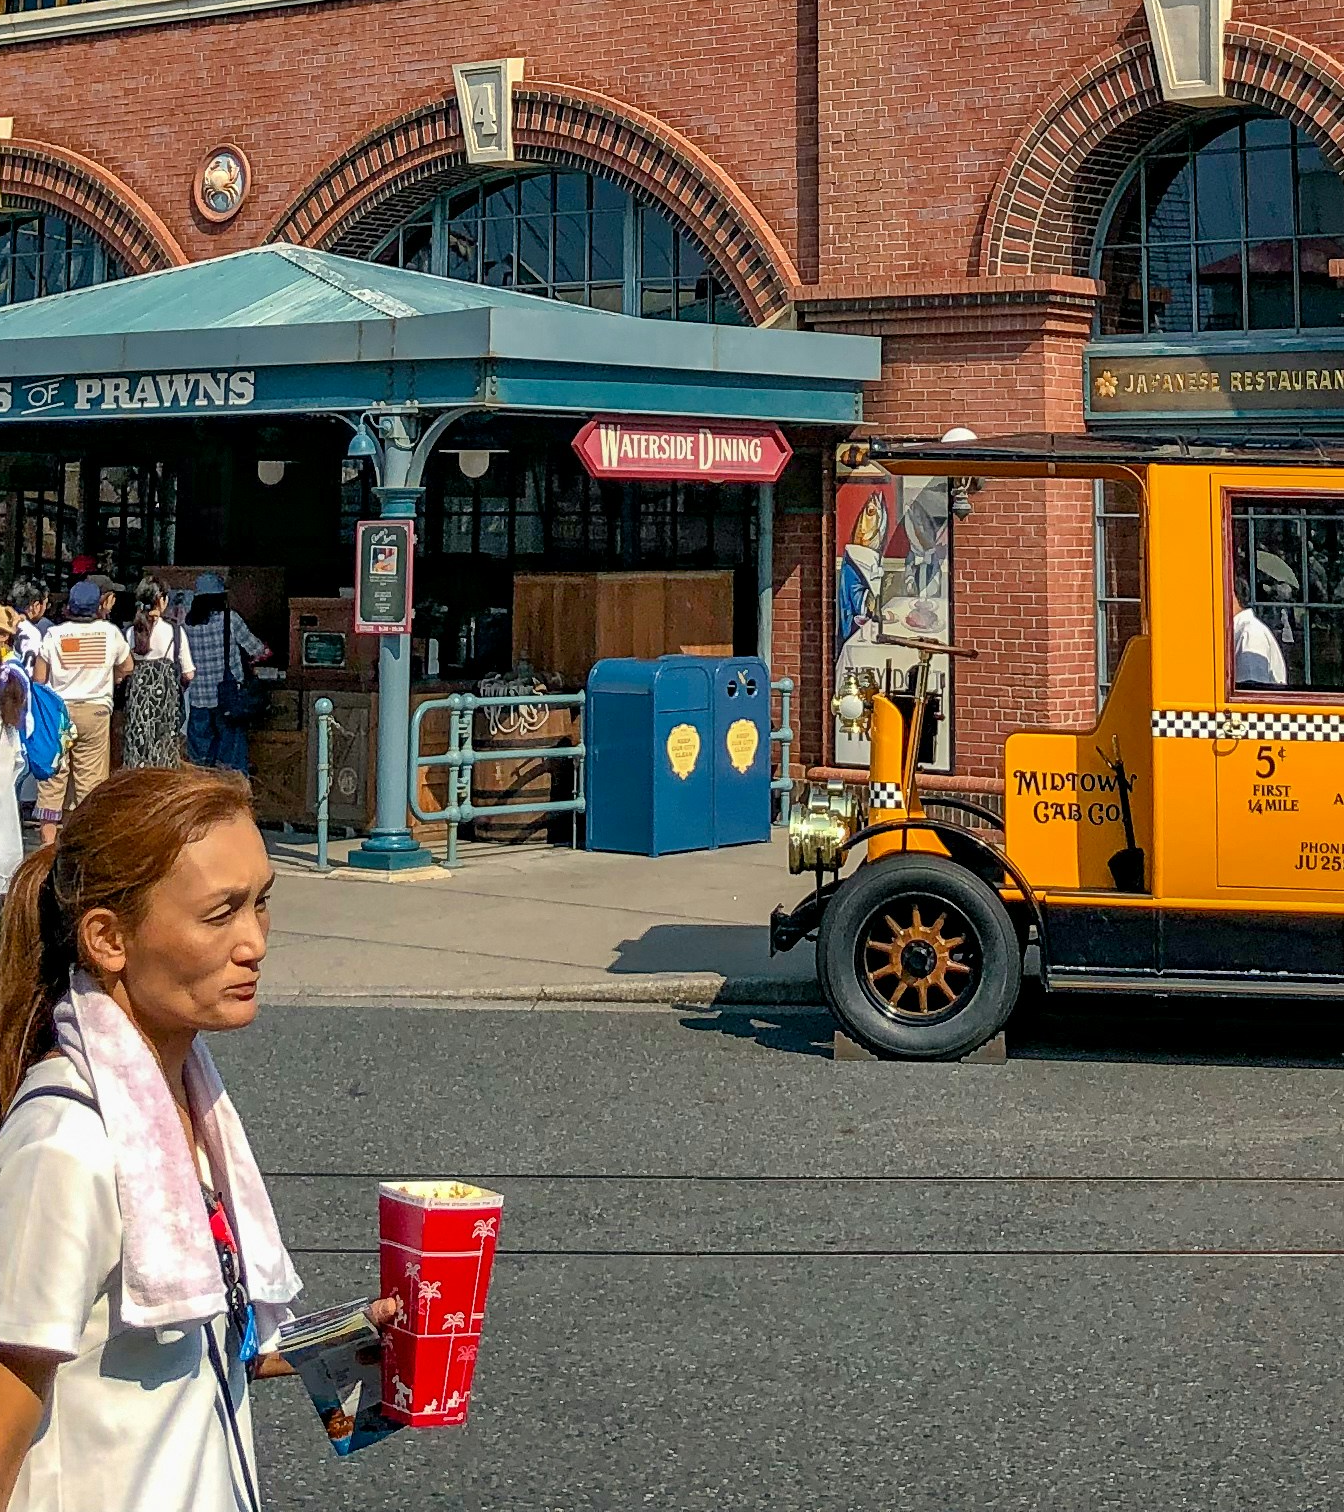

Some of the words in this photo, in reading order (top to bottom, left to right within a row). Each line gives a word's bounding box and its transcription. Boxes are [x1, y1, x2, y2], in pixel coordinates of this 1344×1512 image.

[27, 382, 61, 407] OF
[74, 370, 256, 410] PRAWNS
[1124, 369, 1220, 394] JAPANESE
[599, 423, 695, 468] WATERSIDE
[699, 428, 762, 471] DINING
[1013, 769, 1138, 797] MIDTOWN
[1252, 783, 1292, 798] FIRST
[1032, 800, 1083, 824] CAB
[1265, 798, 1300, 812] MILE
